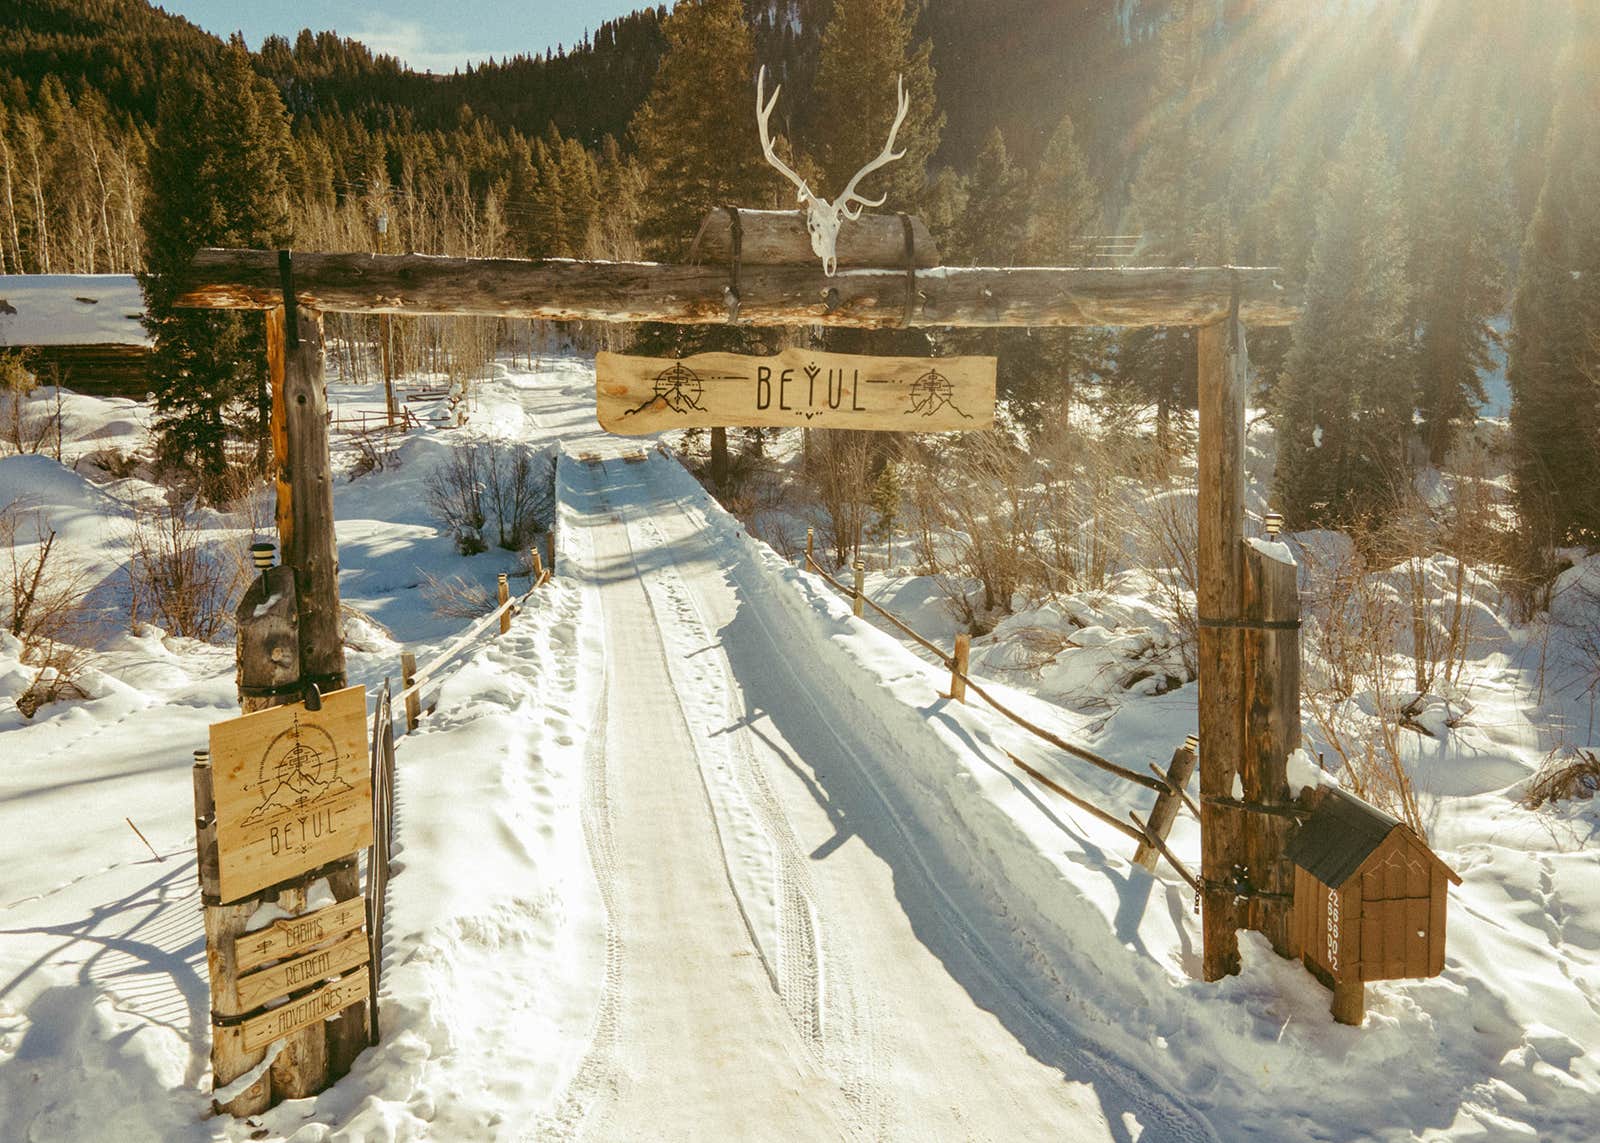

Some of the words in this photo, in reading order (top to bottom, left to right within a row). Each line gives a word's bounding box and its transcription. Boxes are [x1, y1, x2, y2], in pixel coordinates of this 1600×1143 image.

[756, 363, 866, 412] BEYUL
[270, 808, 337, 856] BEYUL
[286, 918, 323, 947] CABINS
[285, 951, 331, 986] RETREAT
[278, 987, 342, 1032] ADVENTURES
